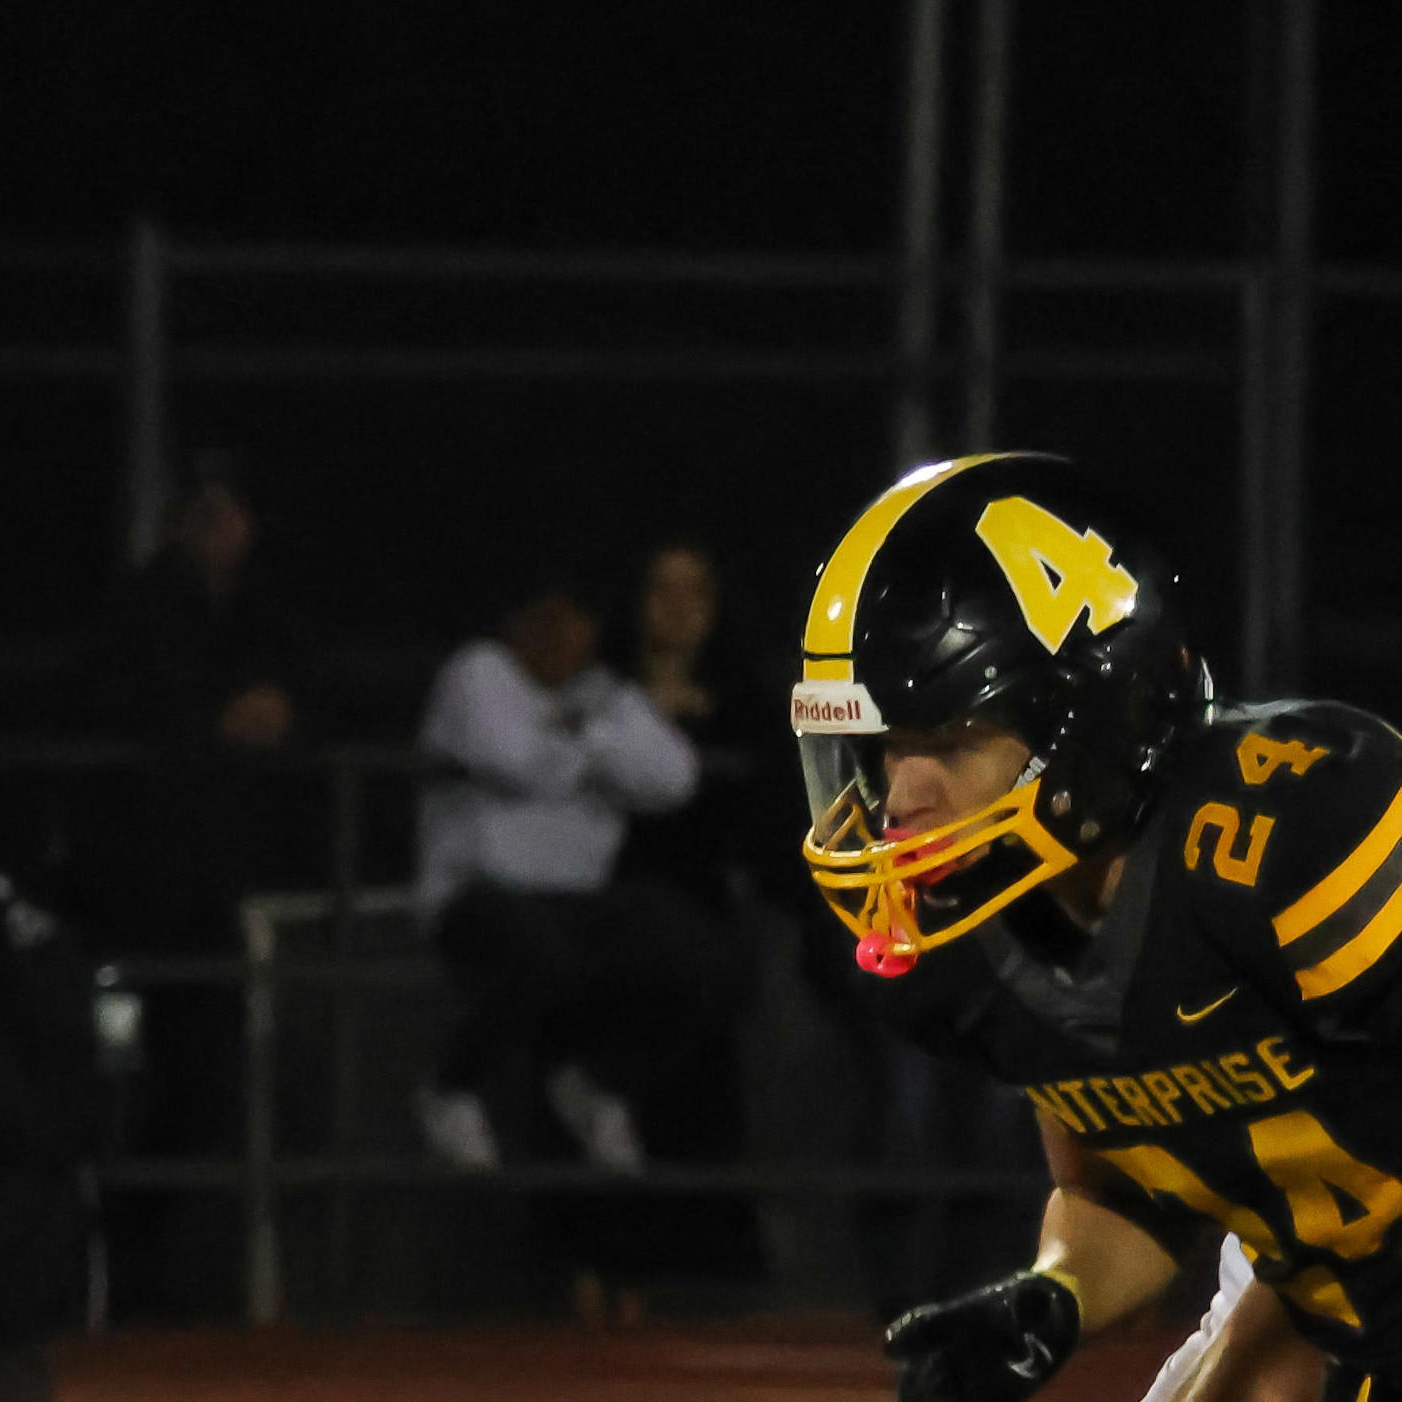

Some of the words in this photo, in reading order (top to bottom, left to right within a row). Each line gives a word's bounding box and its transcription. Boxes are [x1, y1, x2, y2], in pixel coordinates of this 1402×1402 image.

[975, 496, 1139, 656] 4
[794, 699, 861, 721] Riddell
[1183, 732, 1331, 887] 24
